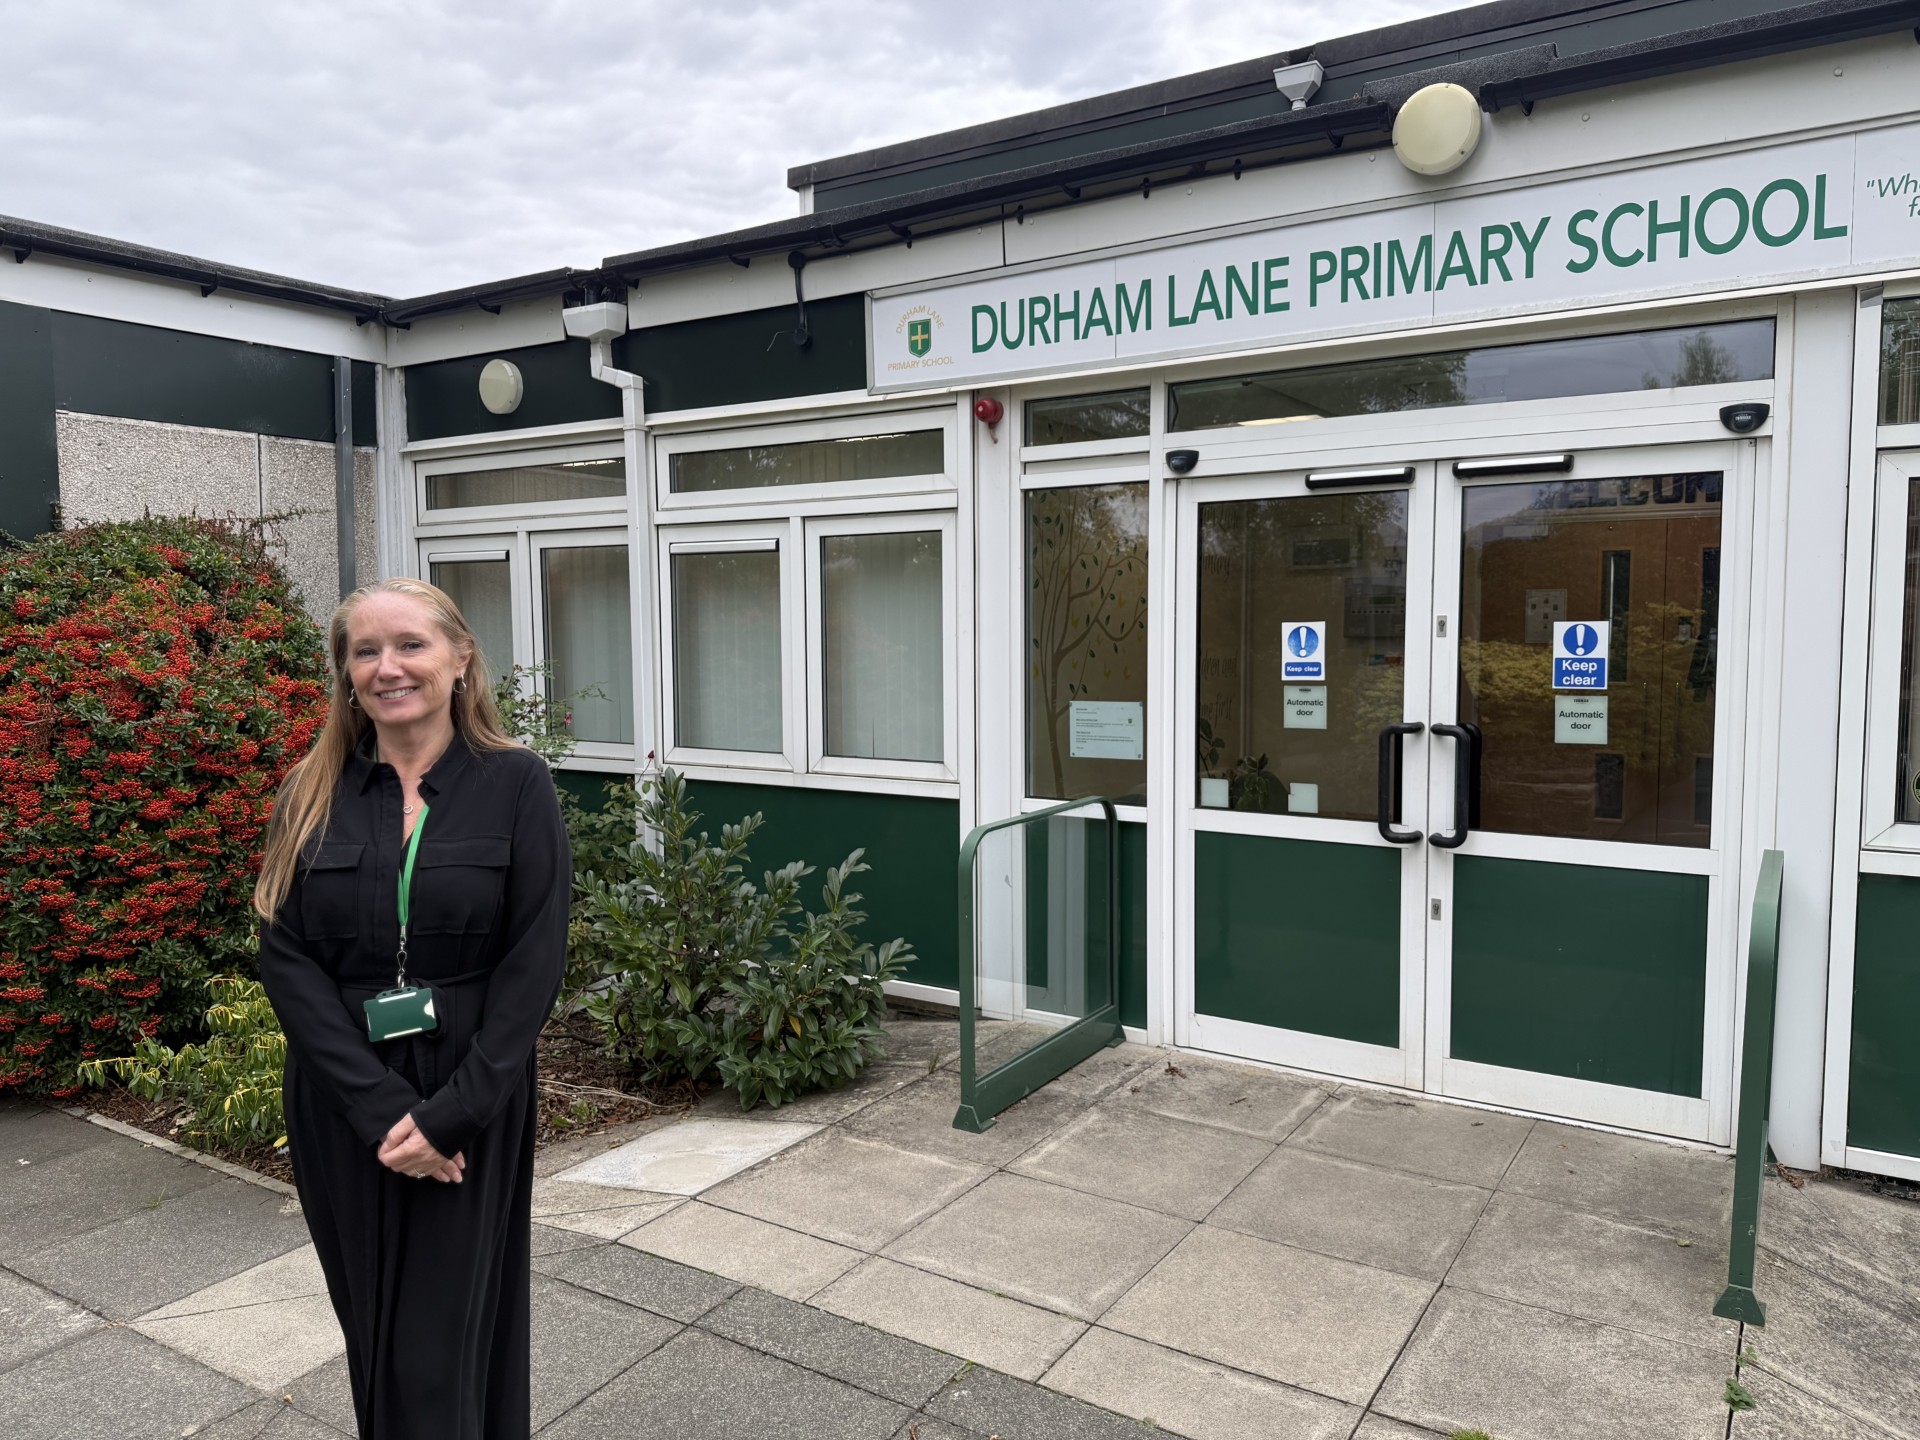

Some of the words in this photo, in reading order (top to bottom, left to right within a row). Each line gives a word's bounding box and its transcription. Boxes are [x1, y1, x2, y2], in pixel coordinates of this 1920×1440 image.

[1866, 173, 1920, 198] "Wh
[972, 279, 1152, 354] DURHAM
[1168, 256, 1291, 328] LANE
[1309, 216, 1551, 308] PRIMARY
[1567, 174, 1848, 274] SCHOOL
[896, 305, 926, 335] DURHAM
[927, 307, 945, 330] LANE
[888, 361, 920, 371] PRIMARY
[922, 357, 954, 367] SCHOOL
[1286, 665, 1303, 673] Keep
[1304, 665, 1320, 673] clear
[1562, 659, 1598, 674] Keep
[1562, 674, 1597, 686] clear
[1286, 698, 1324, 707] Automatic
[1558, 710, 1604, 719] Automatic
[1570, 721, 1592, 730] door
